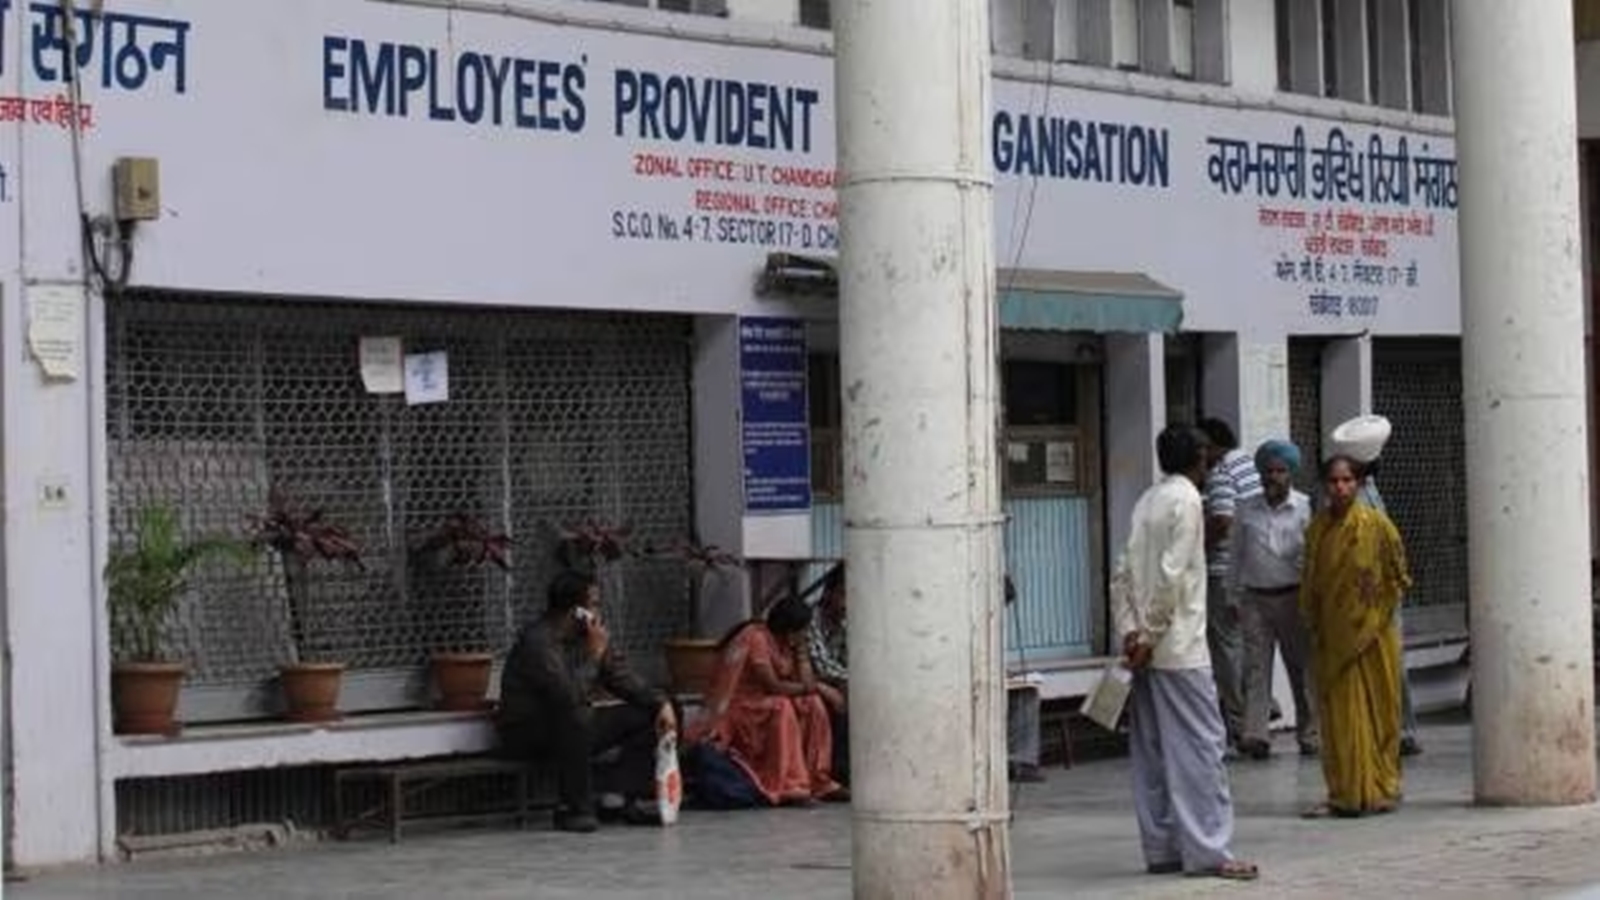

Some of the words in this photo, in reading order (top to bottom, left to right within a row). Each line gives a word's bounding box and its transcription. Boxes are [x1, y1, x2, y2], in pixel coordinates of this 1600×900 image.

[614, 69, 818, 153] PROVIDENT
[992, 110, 1169, 187] GANISATION
[634, 154, 682, 177] ZONAL
[695, 190, 759, 214] REGIONAL
